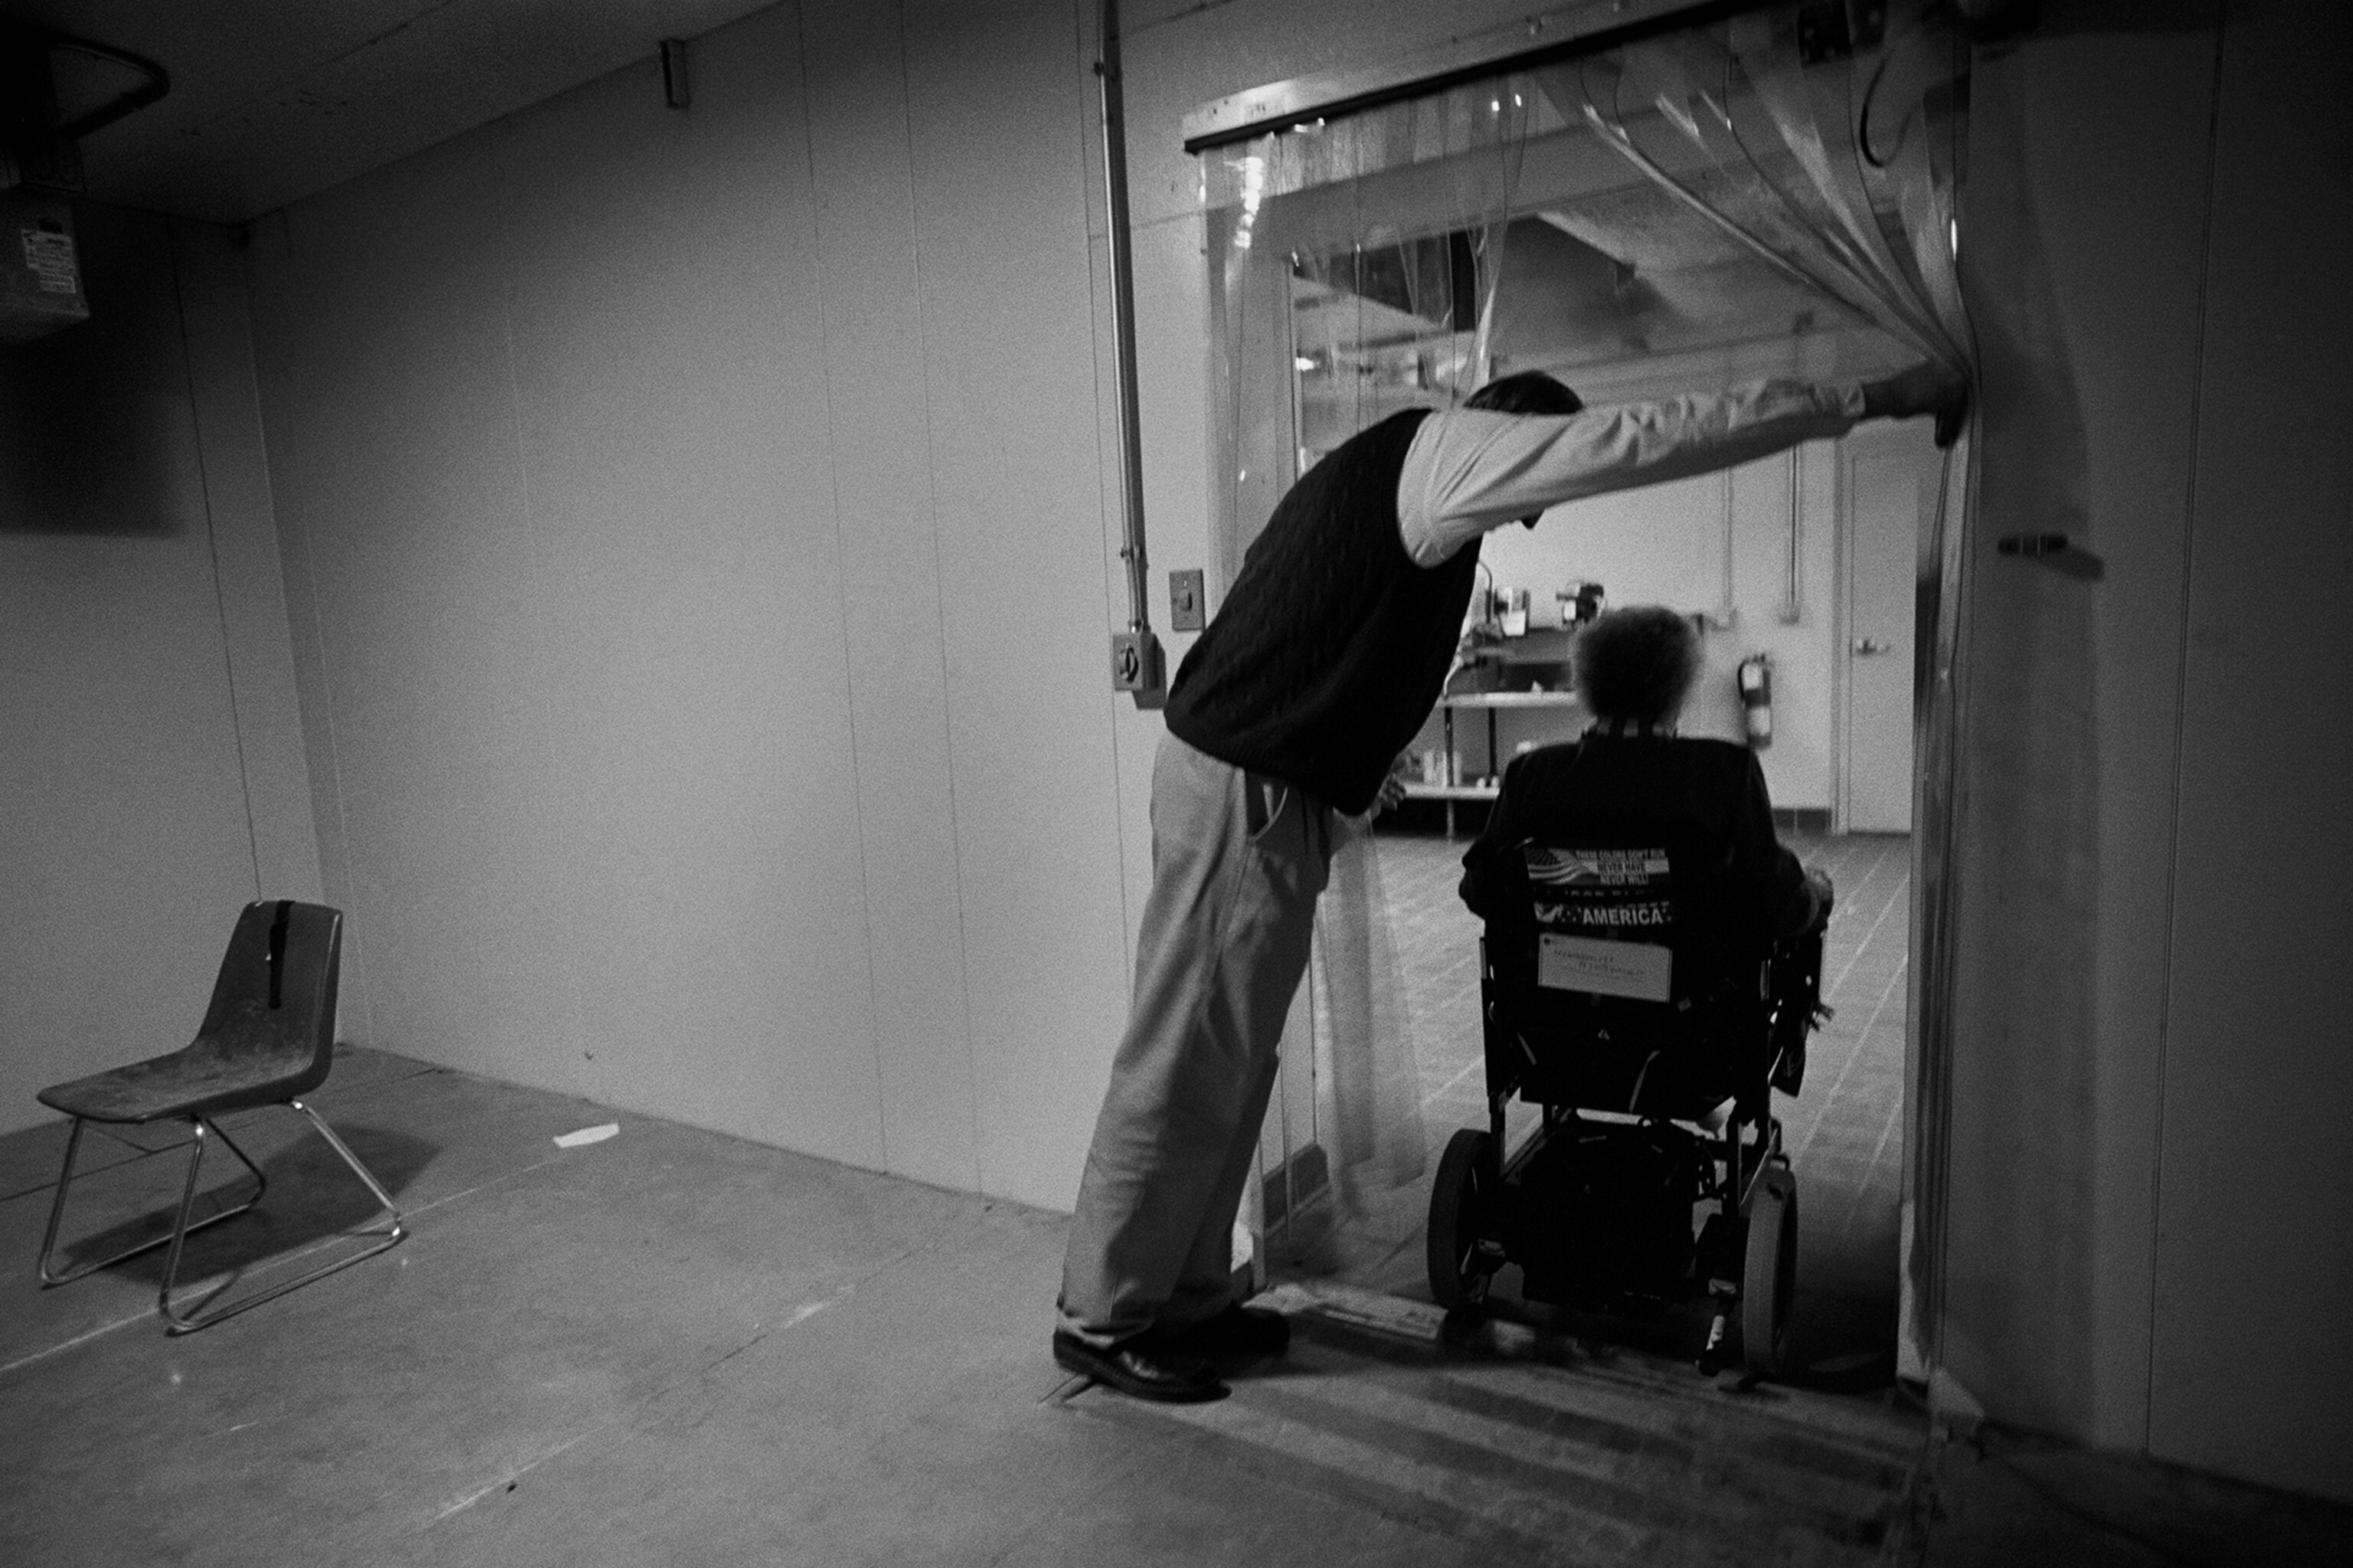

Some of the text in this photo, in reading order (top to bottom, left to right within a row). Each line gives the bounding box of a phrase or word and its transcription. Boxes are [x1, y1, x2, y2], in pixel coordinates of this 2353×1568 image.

[1599, 849, 1626, 861] COLORS
[1597, 860, 1645, 874] NEVER HAVE
[1600, 873, 1625, 885] NEVER
[1582, 908, 1663, 925] AMERICA
